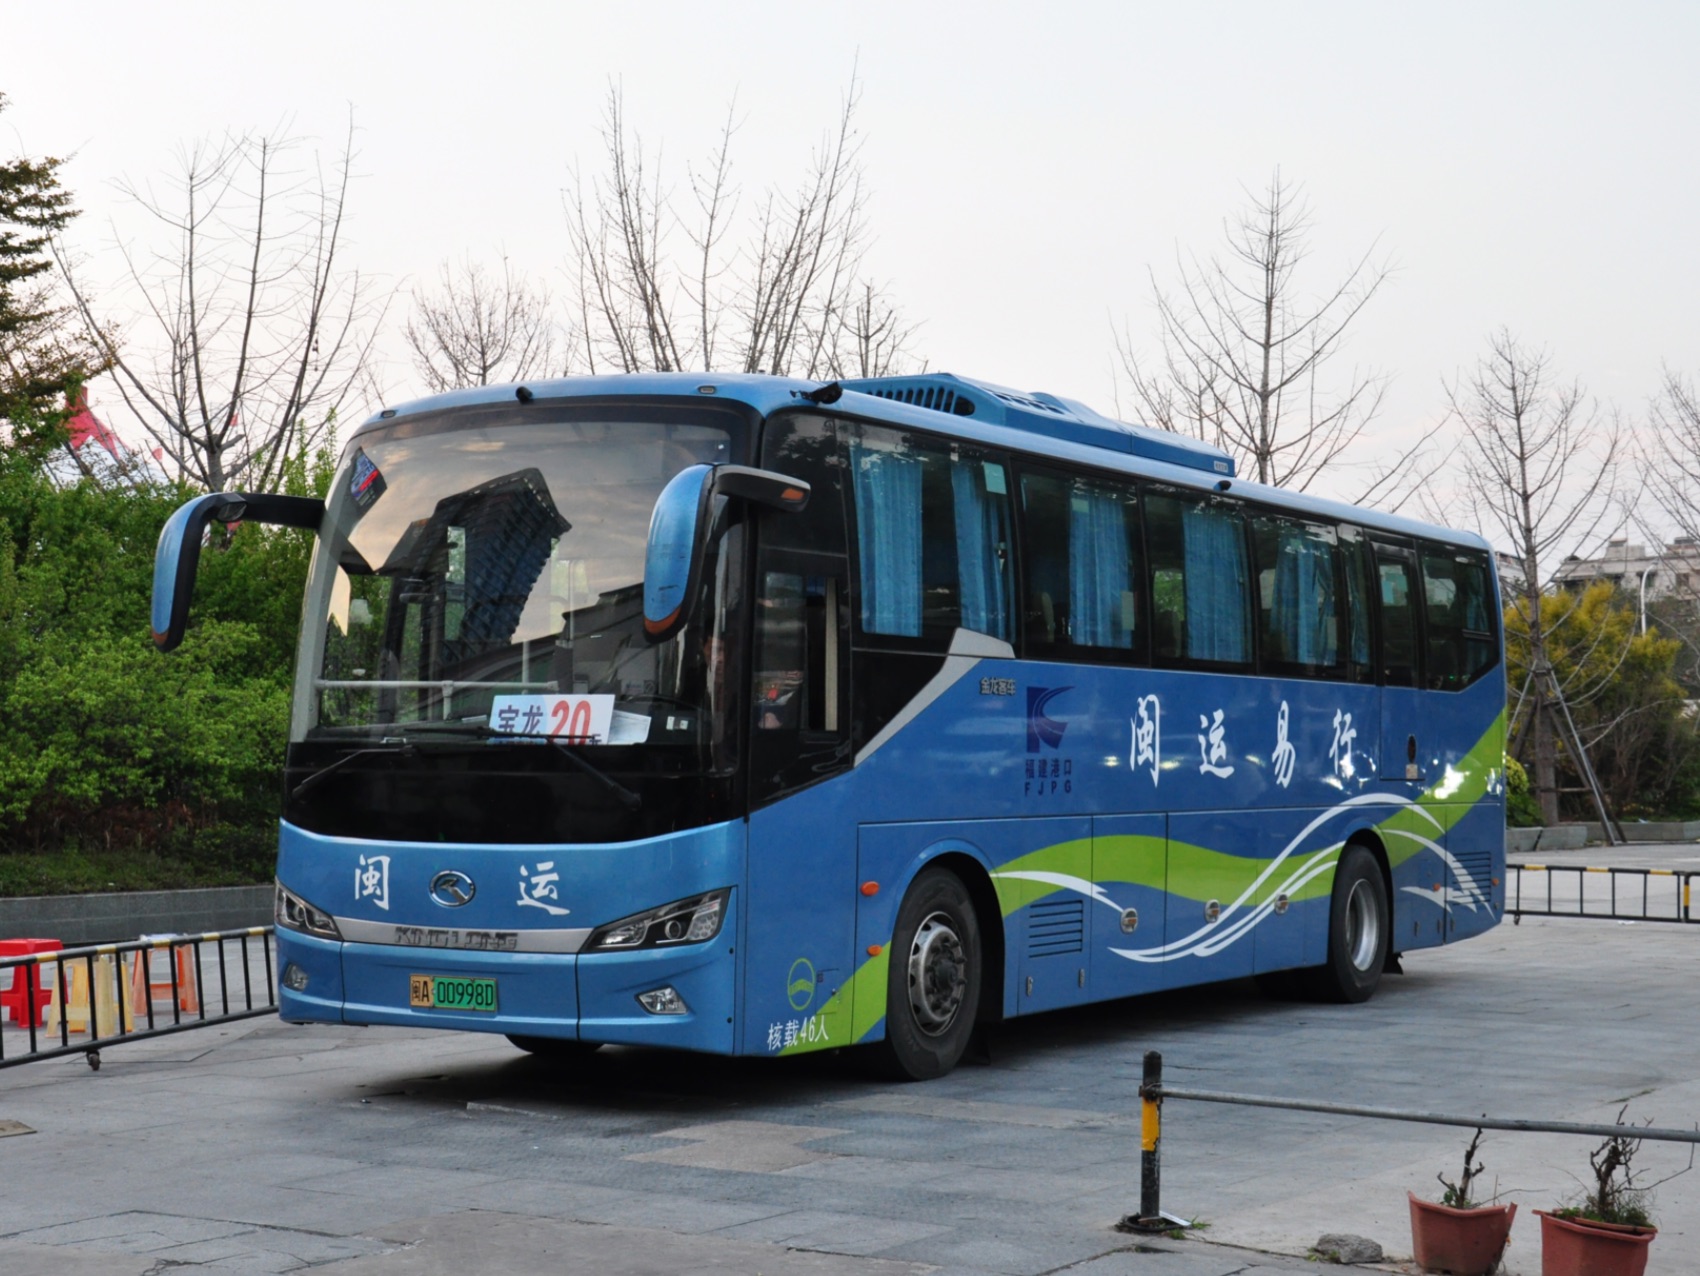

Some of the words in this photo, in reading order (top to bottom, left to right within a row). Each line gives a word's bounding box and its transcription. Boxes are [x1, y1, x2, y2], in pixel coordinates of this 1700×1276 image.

[1129, 694, 1358, 789] 闽运易行
[1025, 758, 1072, 779] 福建港口
[1025, 780, 1072, 797] FJPG
[767, 1014, 829, 1051] 核载46人
